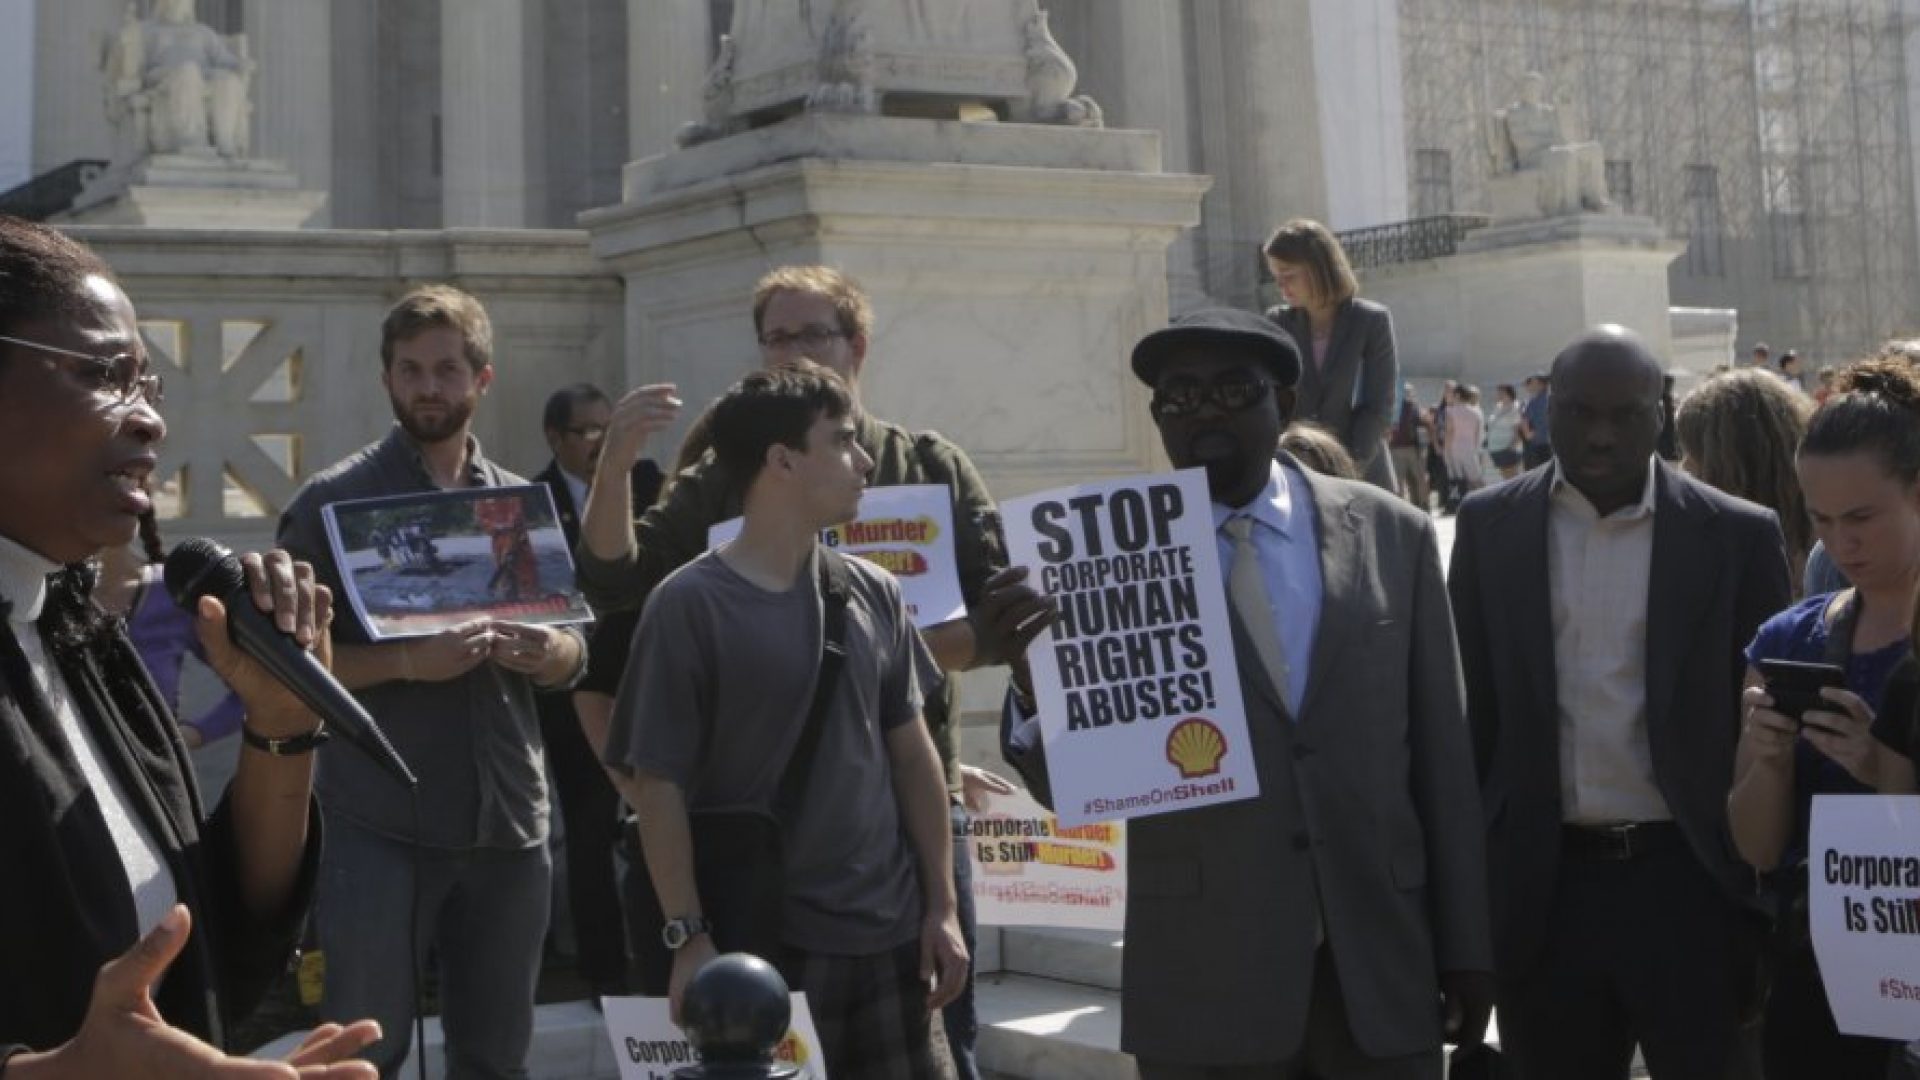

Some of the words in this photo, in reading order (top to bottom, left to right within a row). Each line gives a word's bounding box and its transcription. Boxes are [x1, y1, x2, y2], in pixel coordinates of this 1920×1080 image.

[845, 518, 928, 544] Murder
[1031, 484, 1184, 563] STOP
[1041, 545, 1195, 595] CORPORATE
[1051, 576, 1200, 641] HUMAN
[1054, 624, 1208, 690] RIGHTS
[1066, 671, 1217, 732] ABUSES!
[1083, 778, 1234, 816] #ShameOnShell
[977, 842, 994, 863] Is
[999, 842, 1036, 863] Still
[1823, 848, 1920, 890] Corpora
[1844, 895, 1868, 932] Is
